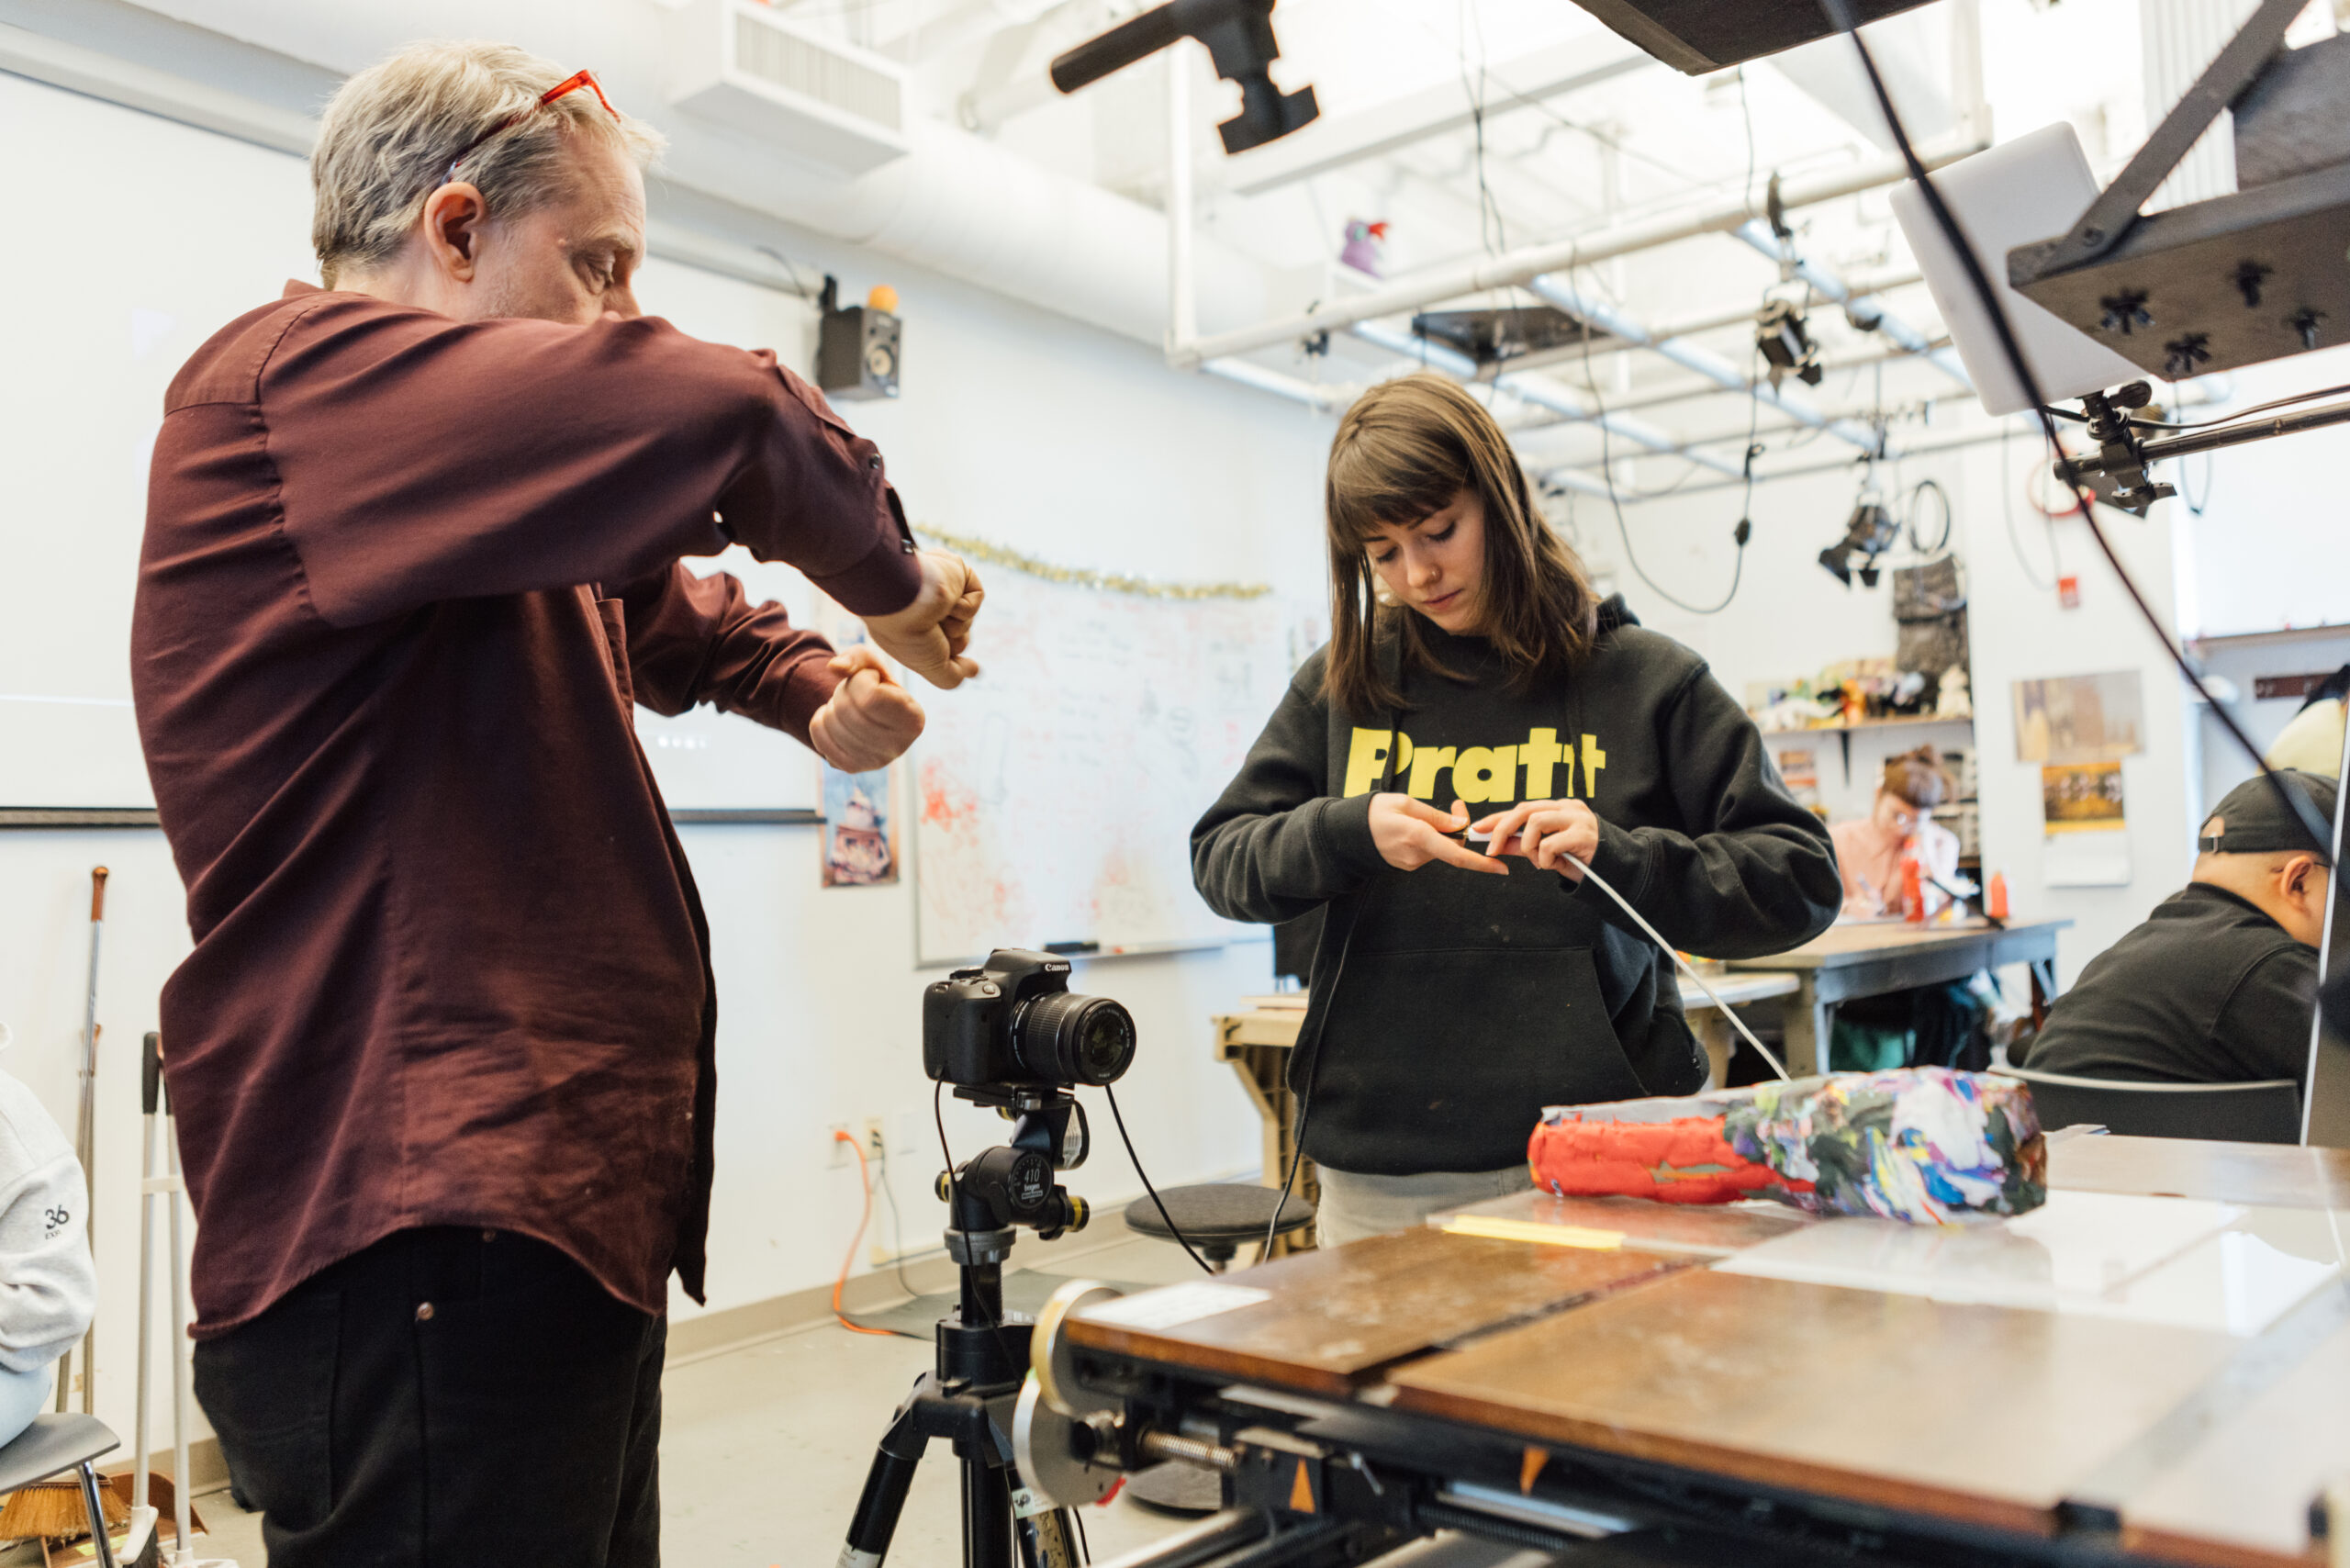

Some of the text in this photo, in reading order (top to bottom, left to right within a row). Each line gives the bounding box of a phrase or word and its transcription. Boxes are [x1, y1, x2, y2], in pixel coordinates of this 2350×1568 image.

[1344, 727, 1606, 803] Pratt
[1045, 963, 1069, 972] Canon
[1024, 1168, 1040, 1183] 410
[45, 1204, 70, 1230] 36
